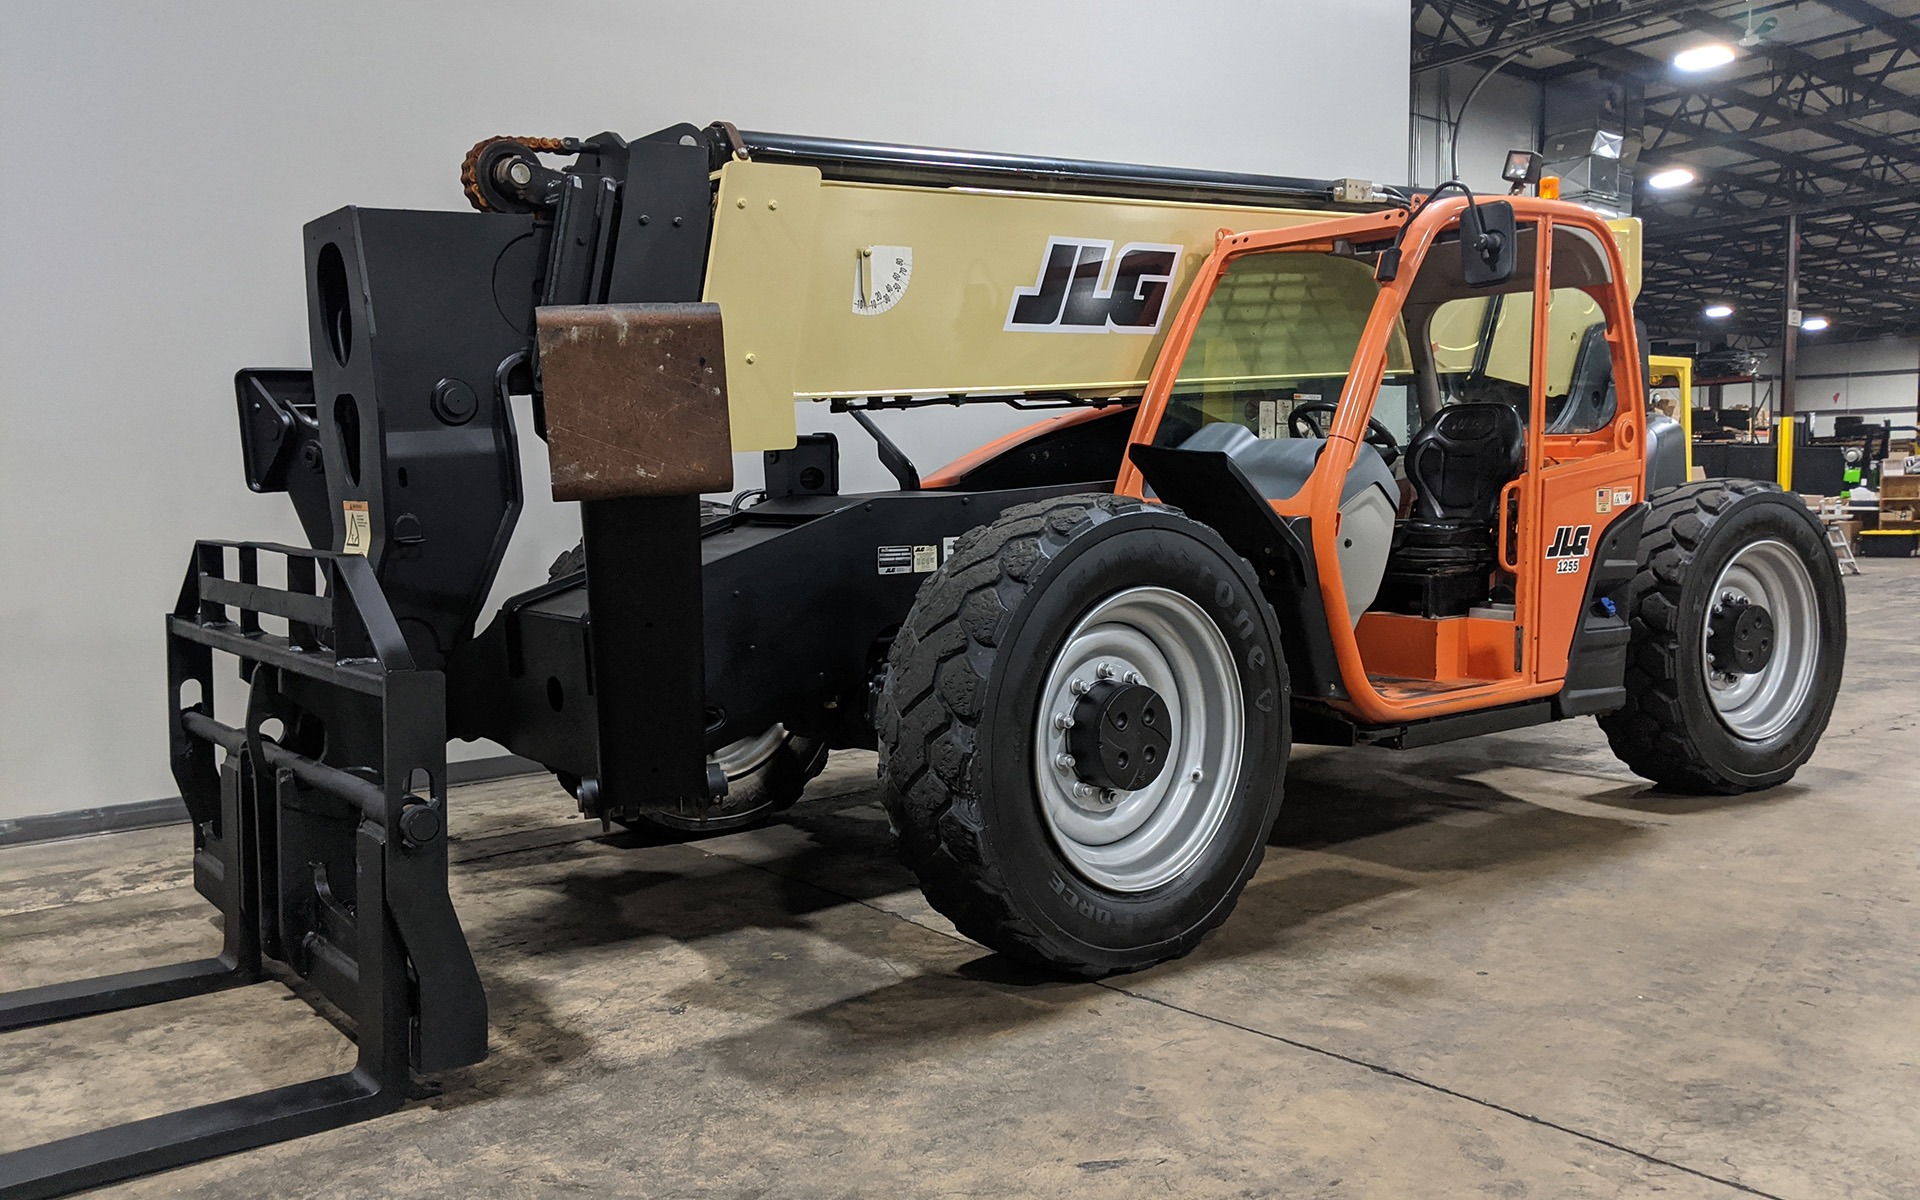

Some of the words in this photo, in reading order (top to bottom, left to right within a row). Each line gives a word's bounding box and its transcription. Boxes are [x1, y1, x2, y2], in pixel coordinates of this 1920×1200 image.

[896, 258, 903, 266] 80
[899, 267, 907, 276] 70
[892, 272, 901, 281] 60
[885, 283, 893, 292] 40
[893, 283, 901, 292] 50
[1010, 242, 1178, 328] JLG
[875, 291, 882, 301] 20
[883, 293, 891, 304] 30
[1546, 526, 1591, 558] JLG
[1557, 560, 1579, 573] 1255
